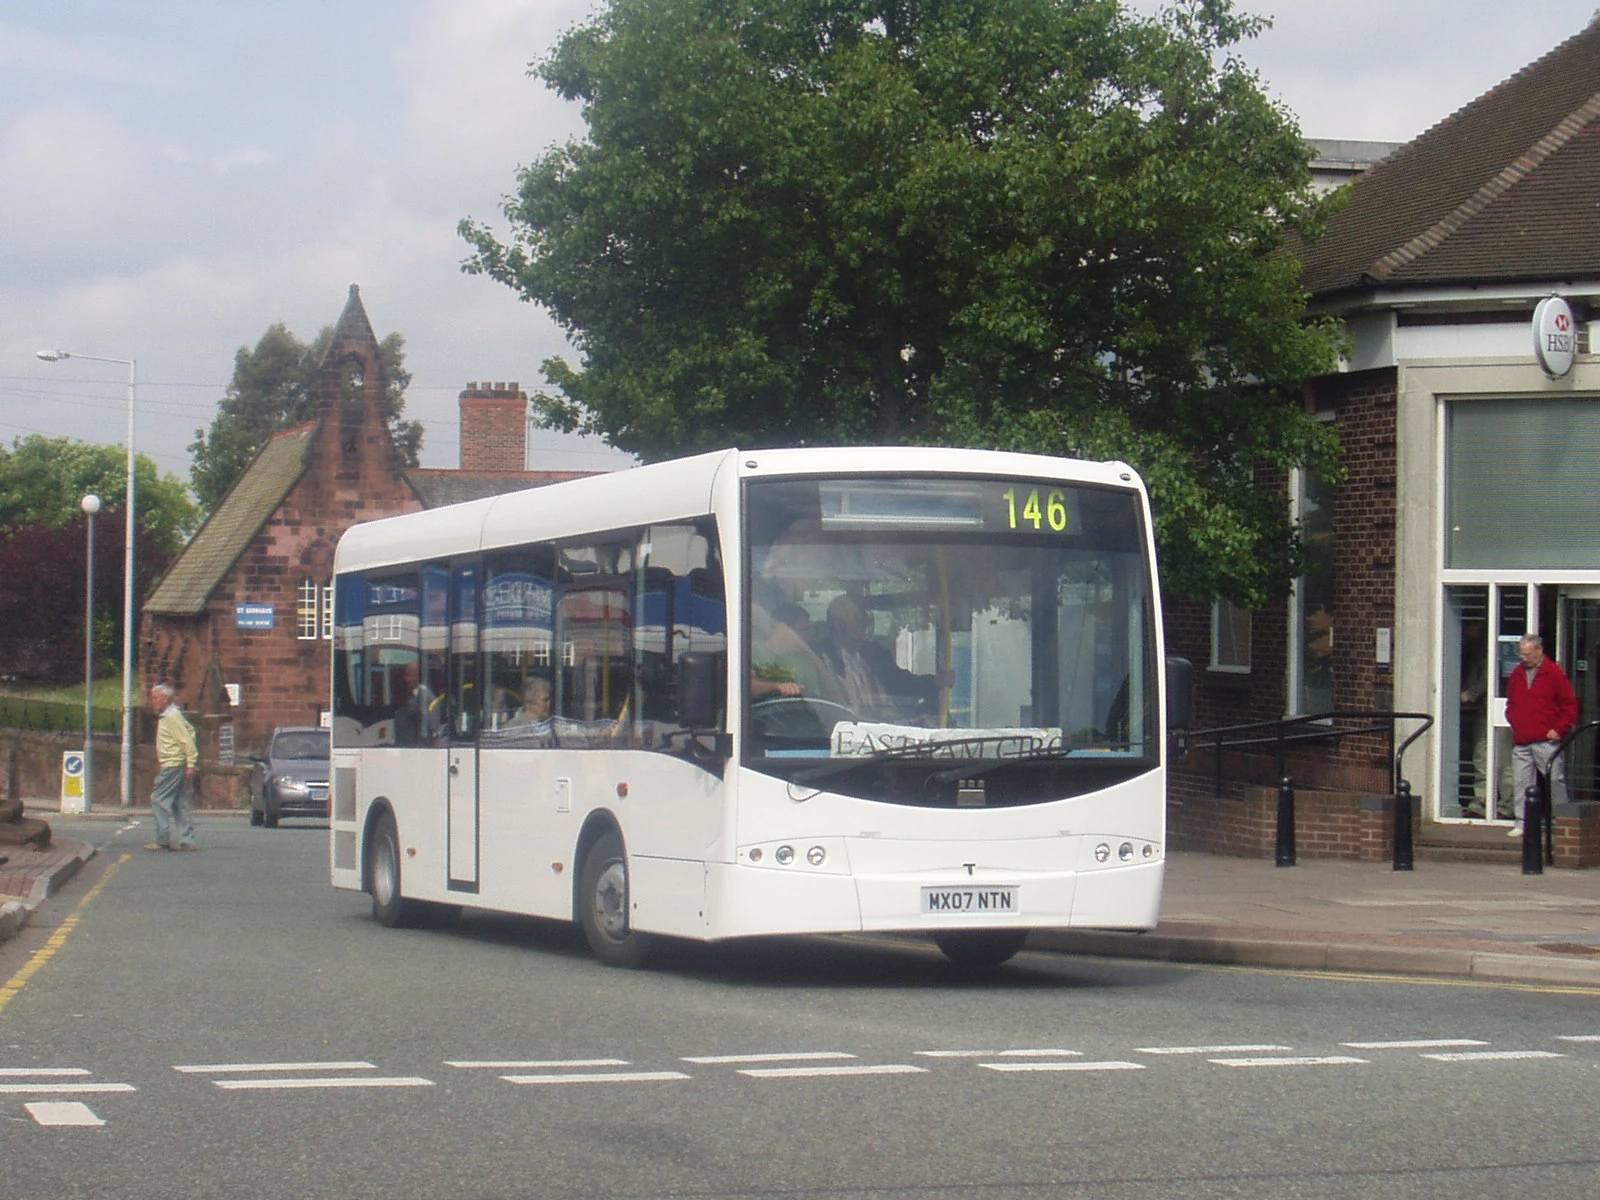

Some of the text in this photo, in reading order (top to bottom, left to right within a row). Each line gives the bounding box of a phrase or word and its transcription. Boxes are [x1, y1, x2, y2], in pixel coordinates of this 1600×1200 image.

[1003, 488, 1066, 531] 146
[929, 891, 1011, 910] MX07 NTN
